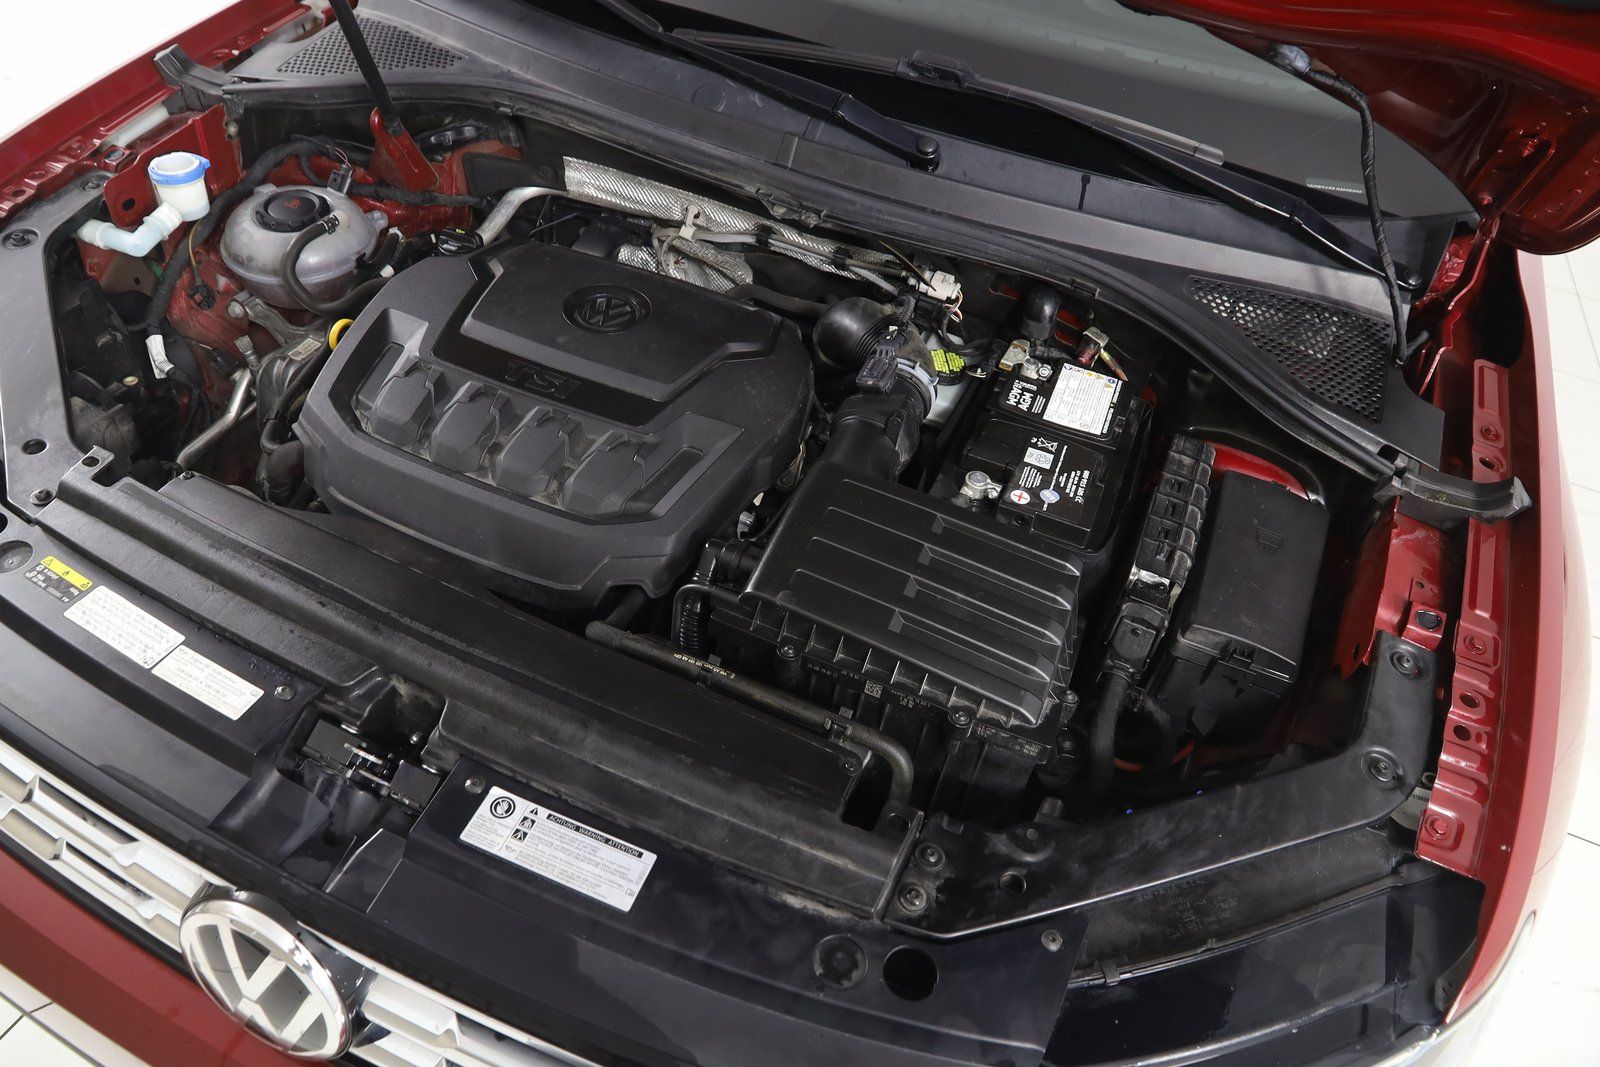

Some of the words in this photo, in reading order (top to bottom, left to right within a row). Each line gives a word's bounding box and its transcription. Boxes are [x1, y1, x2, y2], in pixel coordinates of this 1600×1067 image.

[505, 360, 582, 400] TSI
[1006, 385, 1022, 406] AGM
[1017, 391, 1033, 411] AGM
[547, 814, 577, 830] ACHTUNG
[577, 827, 606, 843] WARNING
[607, 839, 640, 857] ATTENTION
[182, 897, 348, 1056] VW
